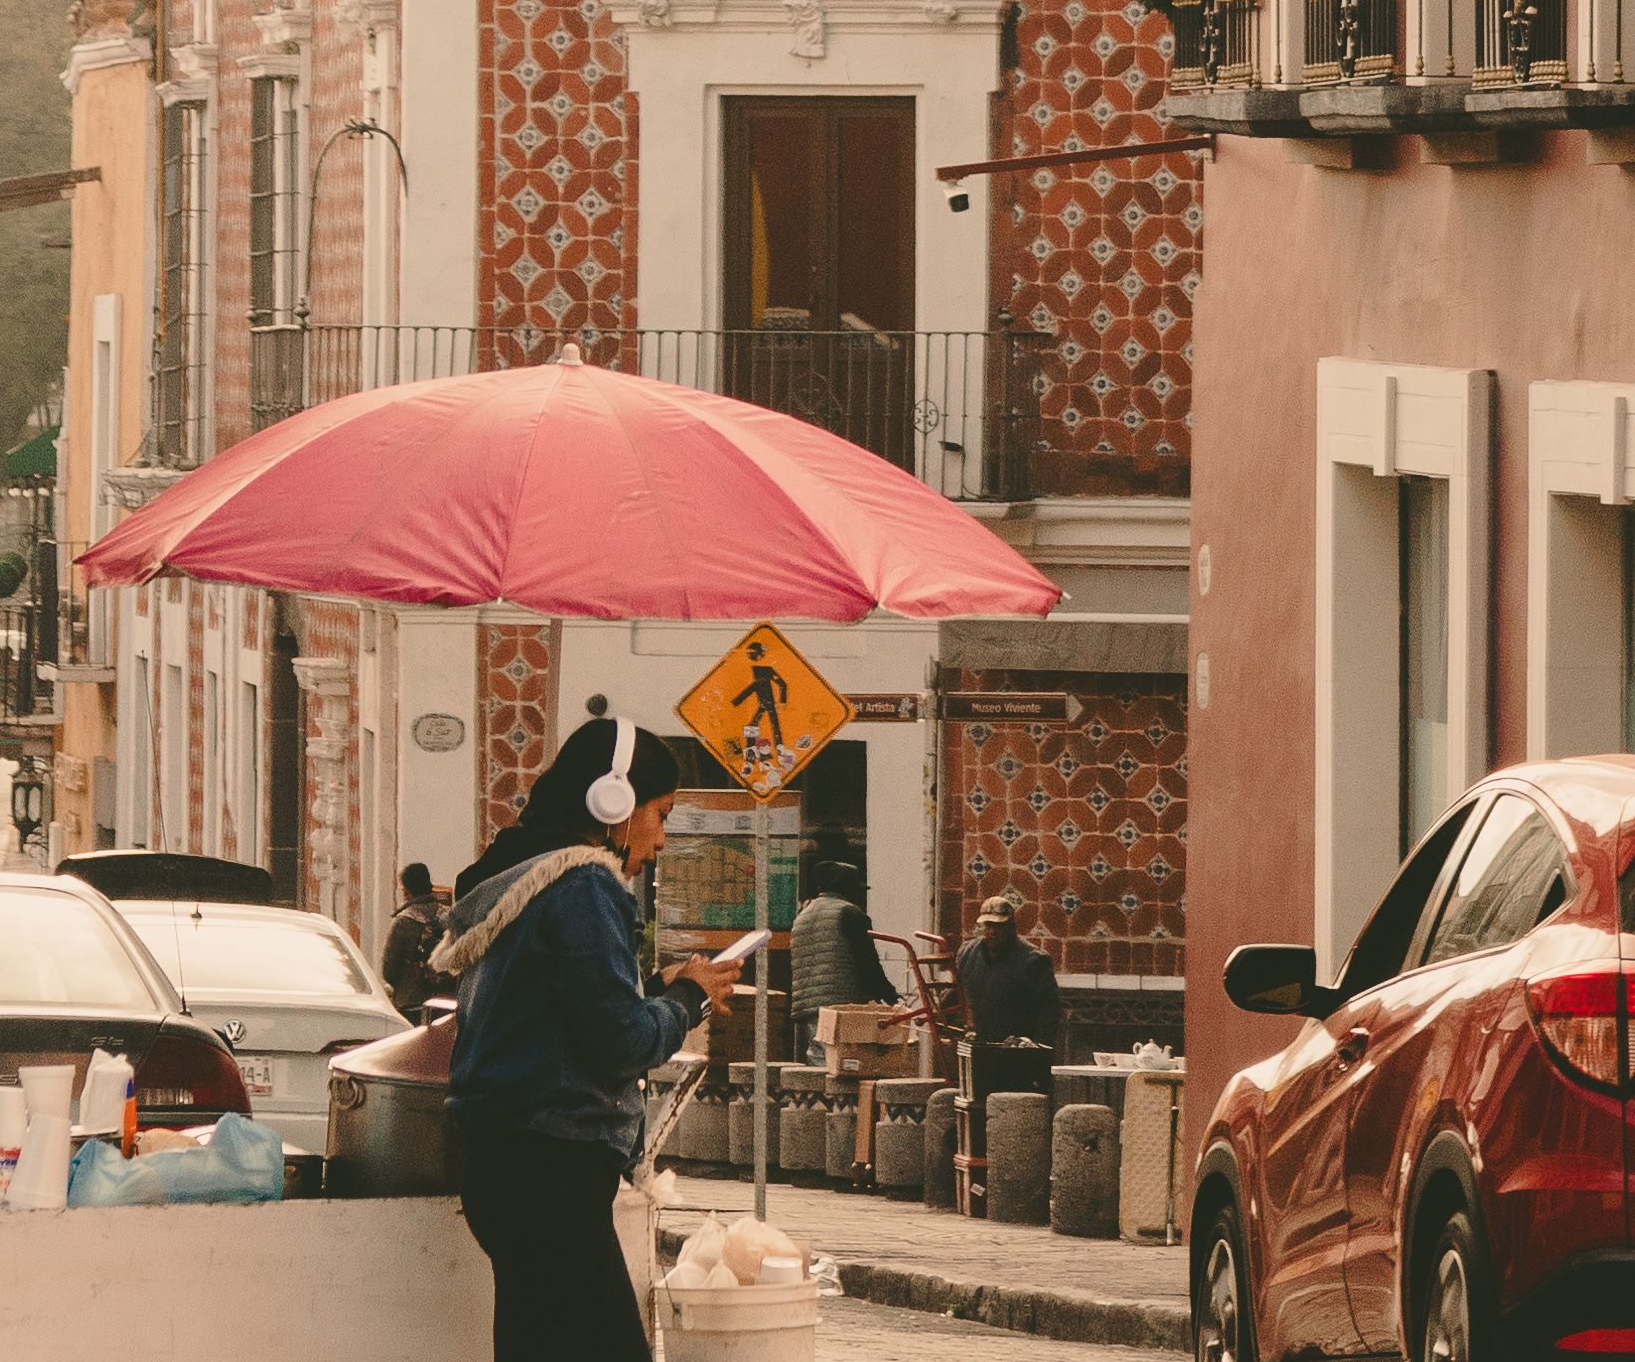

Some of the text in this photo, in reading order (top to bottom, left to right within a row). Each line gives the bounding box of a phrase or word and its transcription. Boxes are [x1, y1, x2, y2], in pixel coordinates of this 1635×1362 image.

[865, 703, 896, 713] Artista
[971, 703, 1041, 713] Museo Viviente
